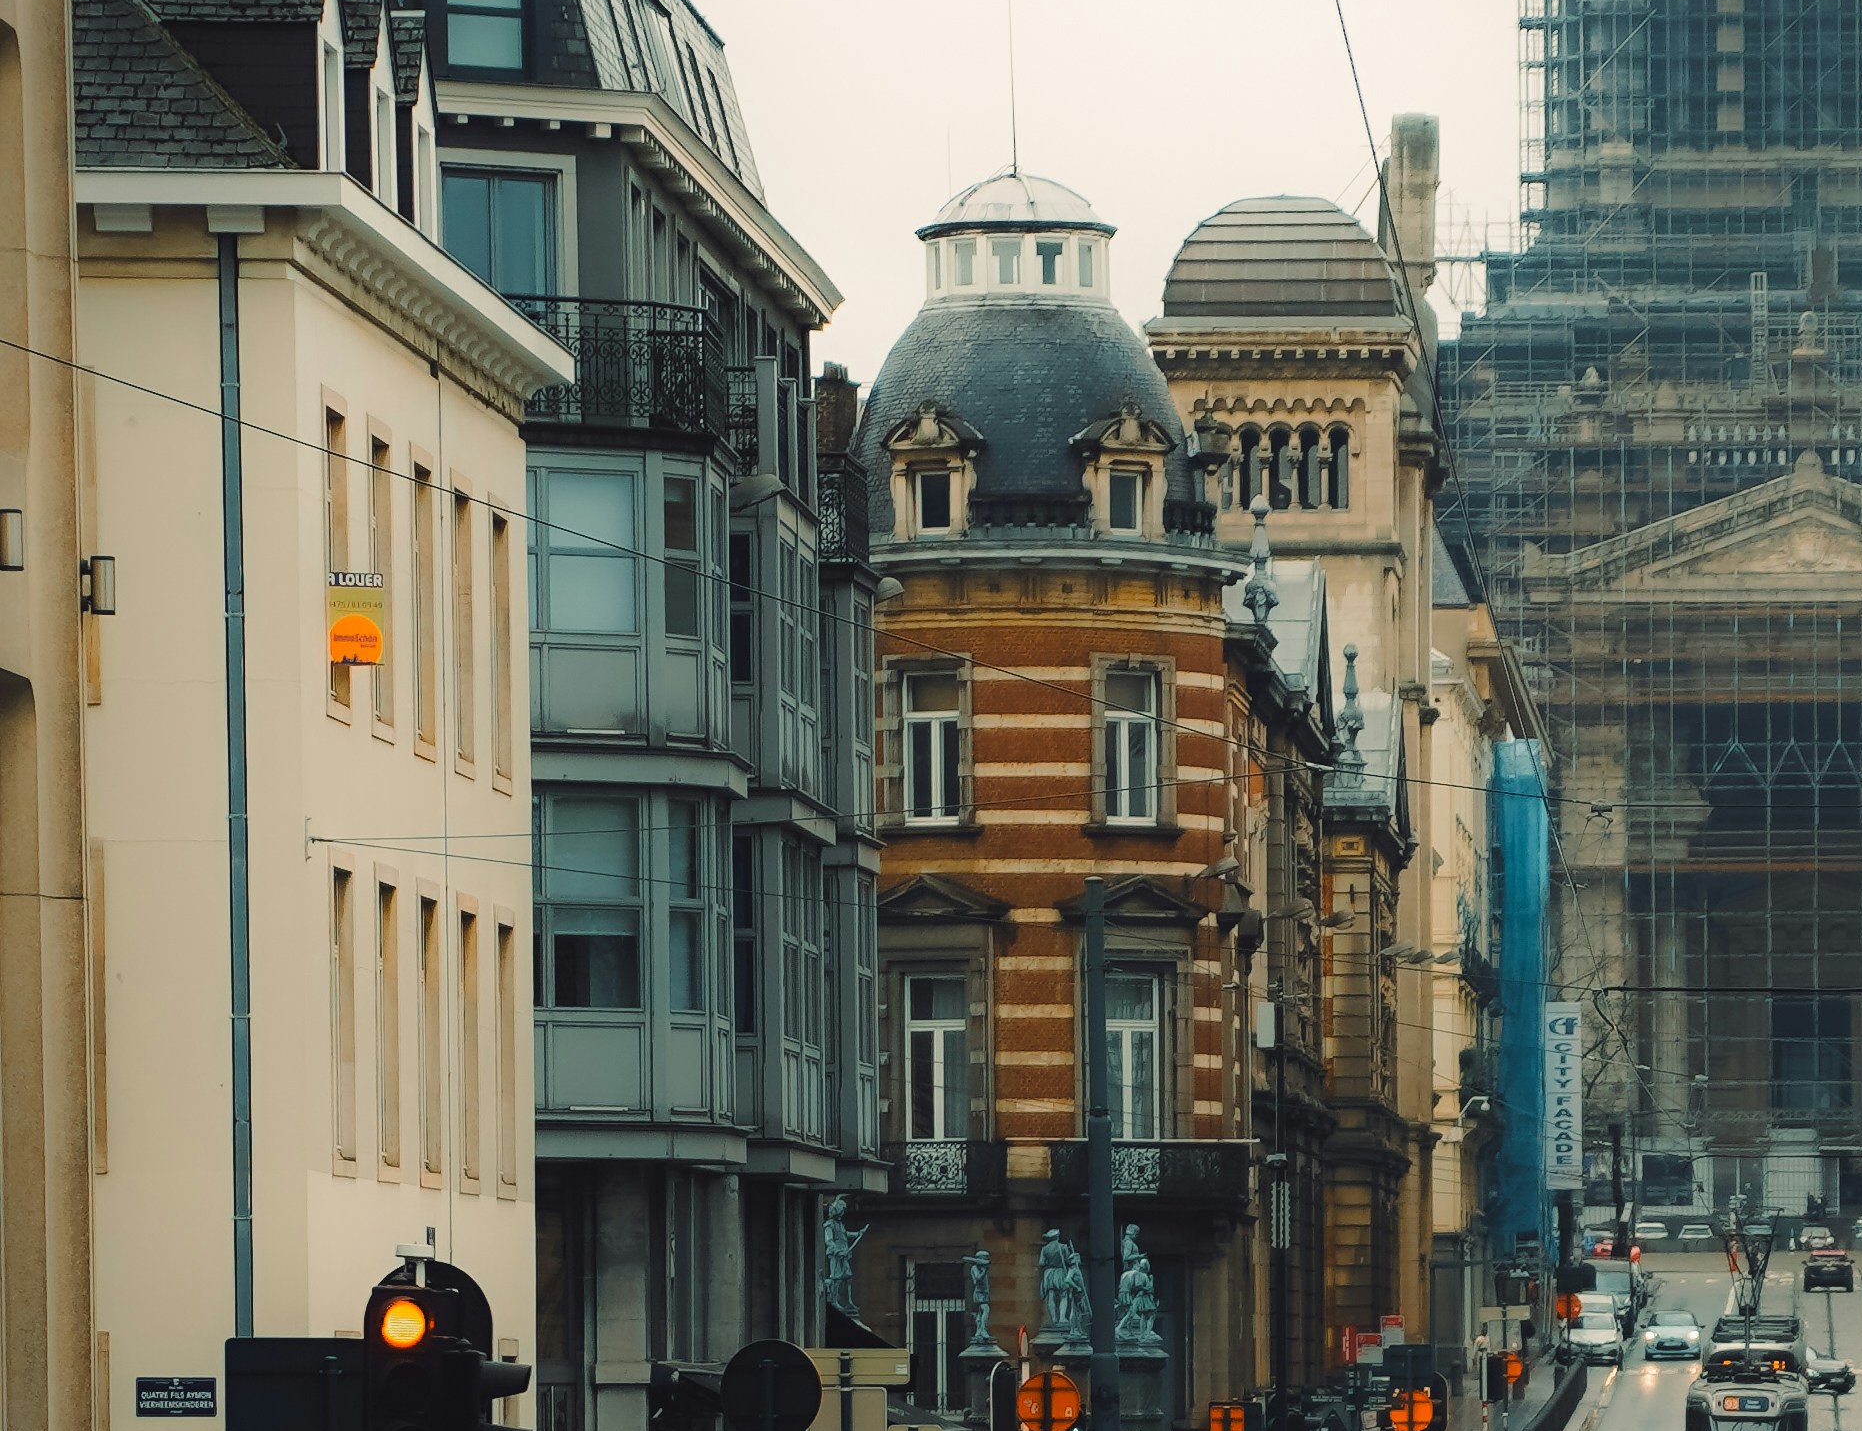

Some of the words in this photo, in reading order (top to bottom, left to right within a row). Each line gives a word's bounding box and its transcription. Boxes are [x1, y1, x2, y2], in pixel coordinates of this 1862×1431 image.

[338, 572, 383, 587] LOUER
[1554, 1042, 1573, 1089] CITY
[141, 1391, 168, 1399] QUATRE
[170, 1391, 184, 1399] FILS
[186, 1391, 212, 1399] AYMON
